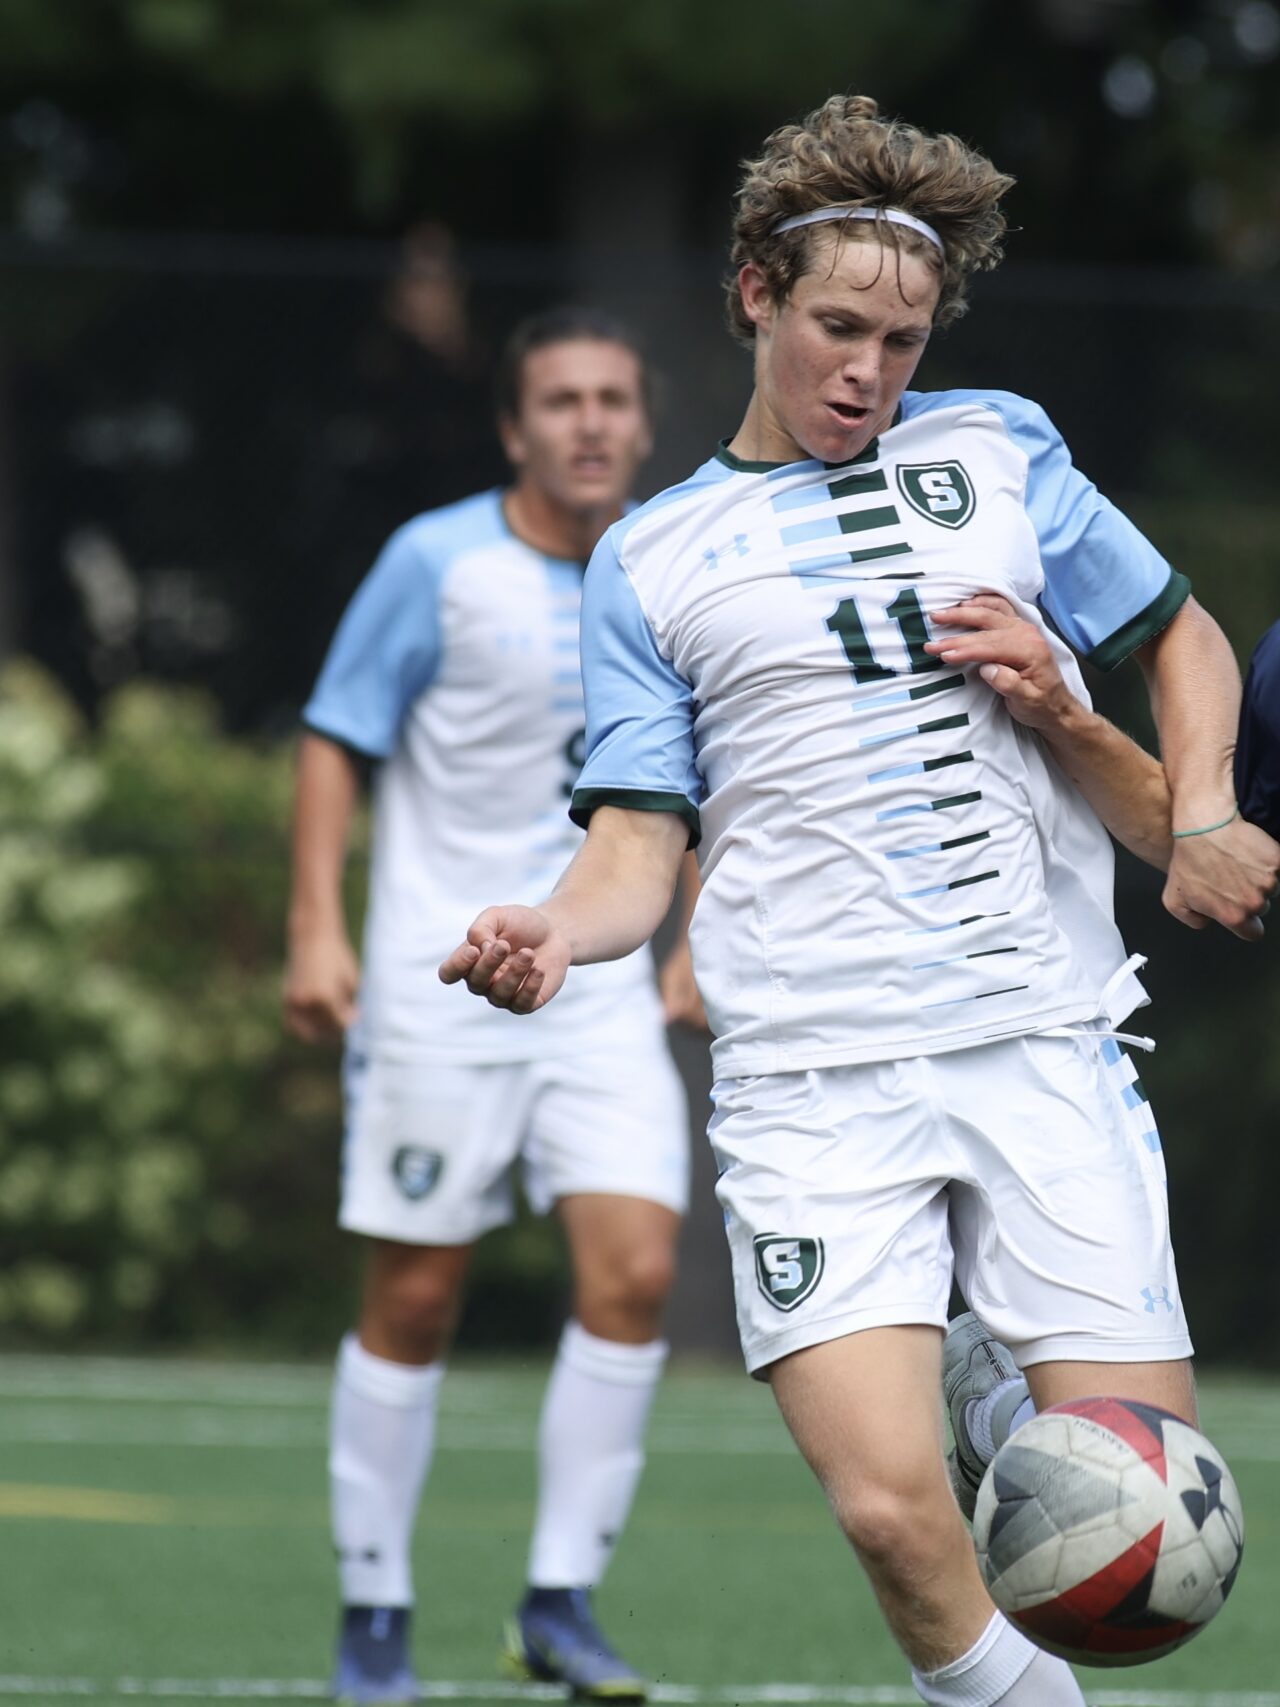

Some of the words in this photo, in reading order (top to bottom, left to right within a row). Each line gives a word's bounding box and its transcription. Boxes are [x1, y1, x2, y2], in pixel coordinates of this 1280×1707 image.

[917, 470, 964, 513] S
[824, 586, 943, 686] 11
[762, 1240, 804, 1293] S
